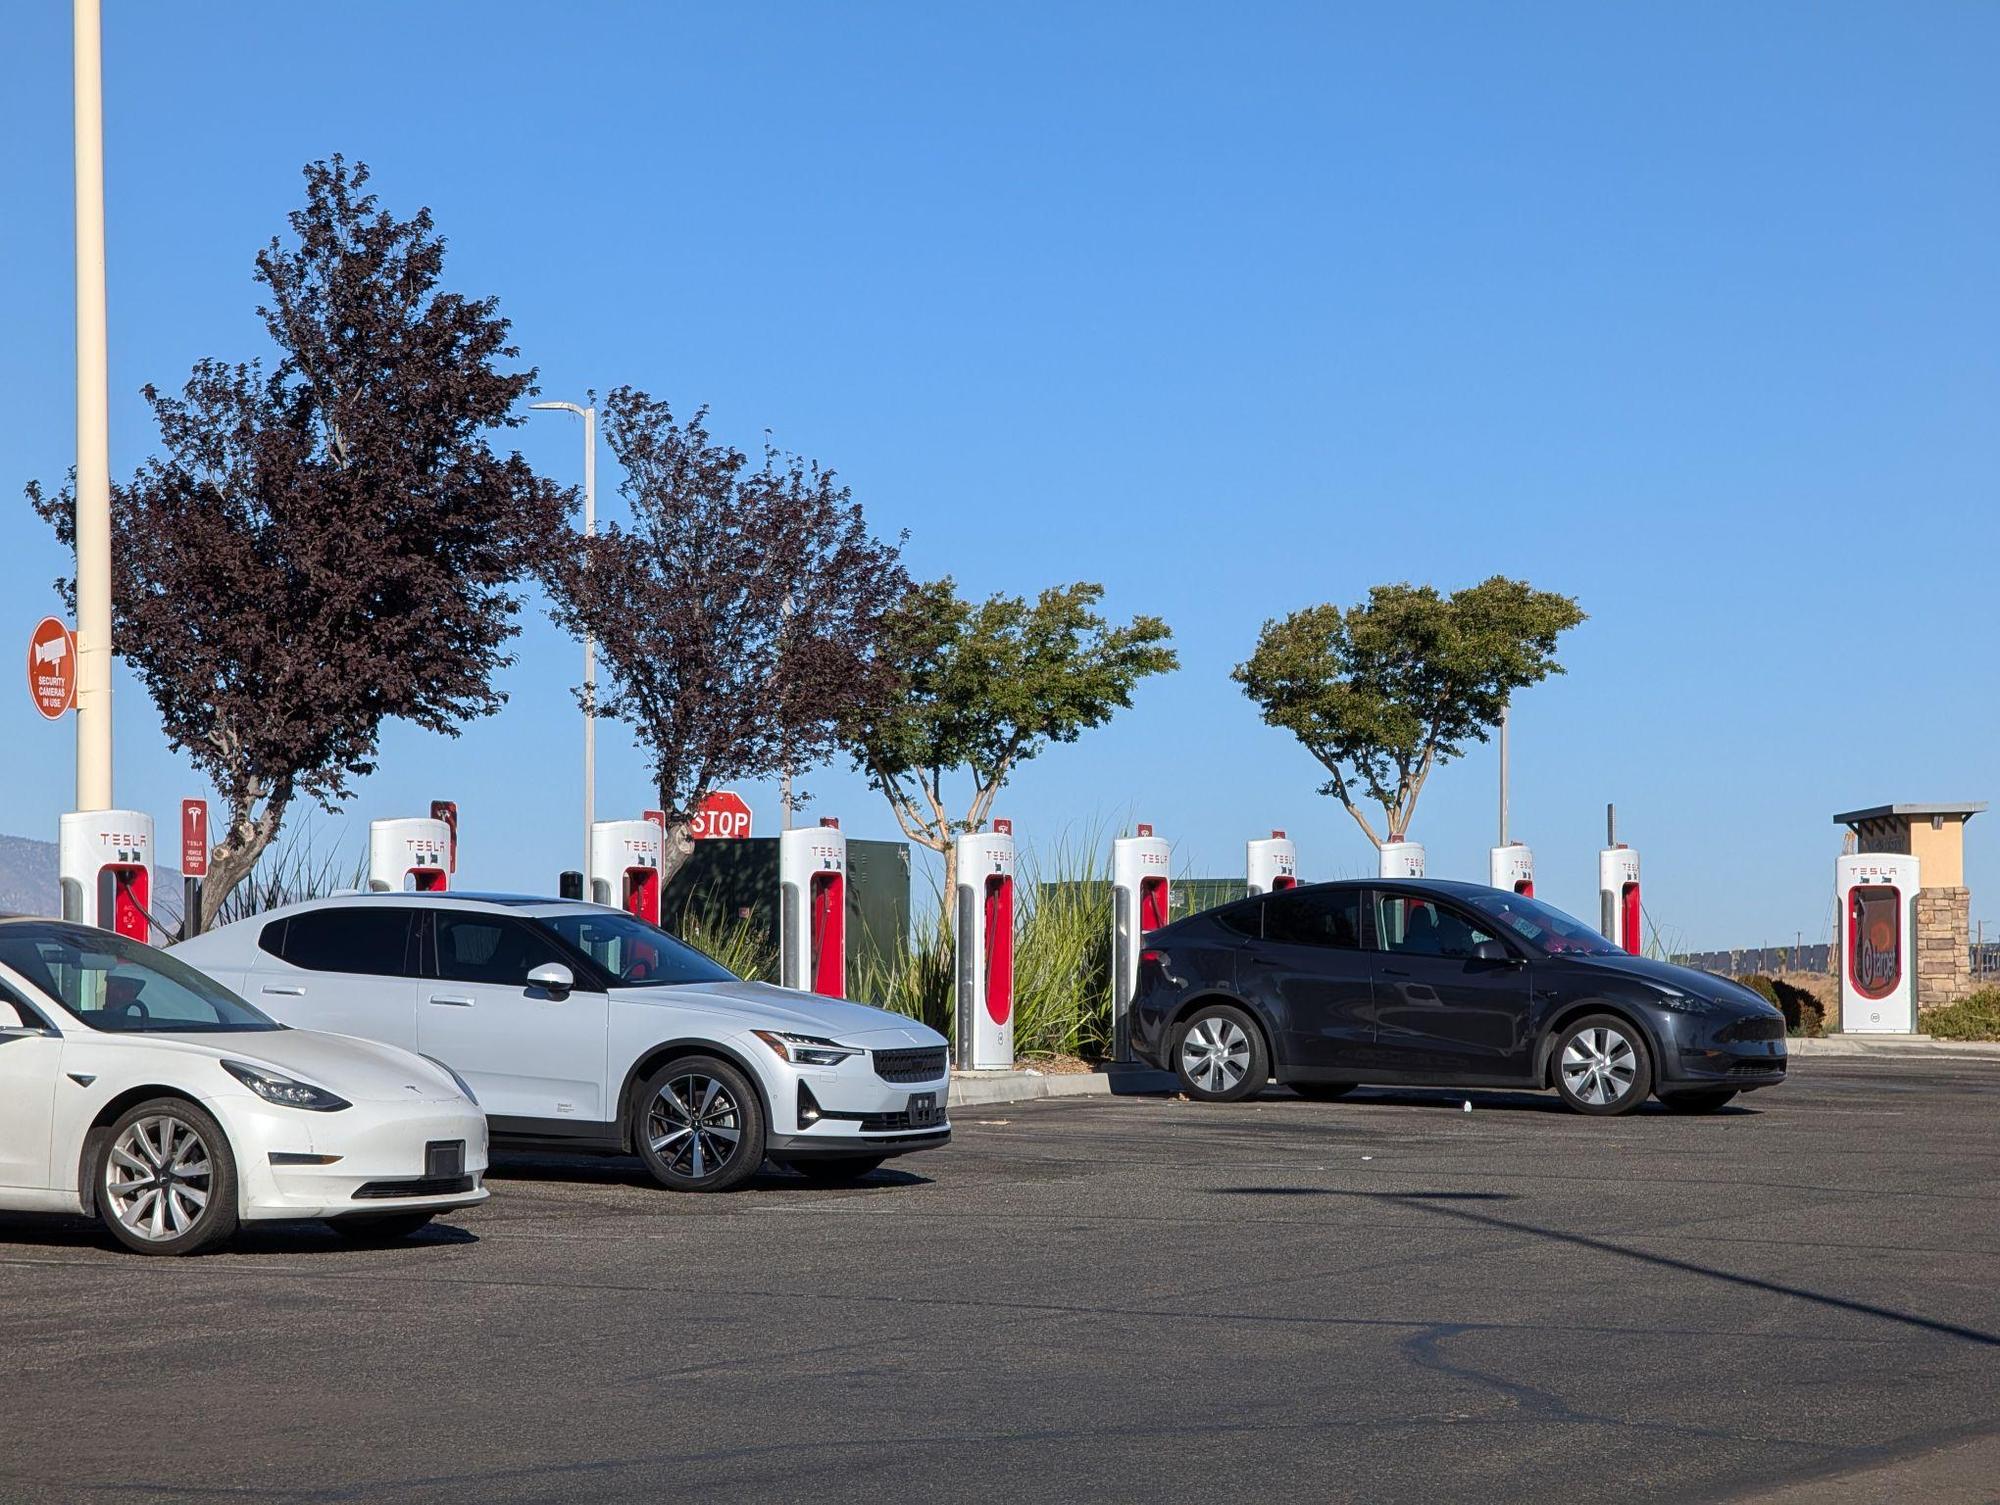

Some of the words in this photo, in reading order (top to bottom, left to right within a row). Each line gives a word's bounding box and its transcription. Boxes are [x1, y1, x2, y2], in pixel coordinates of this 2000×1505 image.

[38, 676, 65, 686] SECURITY
[38, 687, 65, 697] CAMERAS
[43, 699, 49, 707] IN
[50, 699, 61, 707] USE
[692, 811, 748, 835] STOP
[100, 833, 146, 847] TESLA
[406, 840, 445, 852] TESLA
[624, 840, 658, 852] TESLA
[811, 846, 843, 857] TESLA
[986, 850, 1012, 862] TESLA
[1142, 853, 1168, 864] TESLA
[1849, 867, 1897, 875] TESLA
